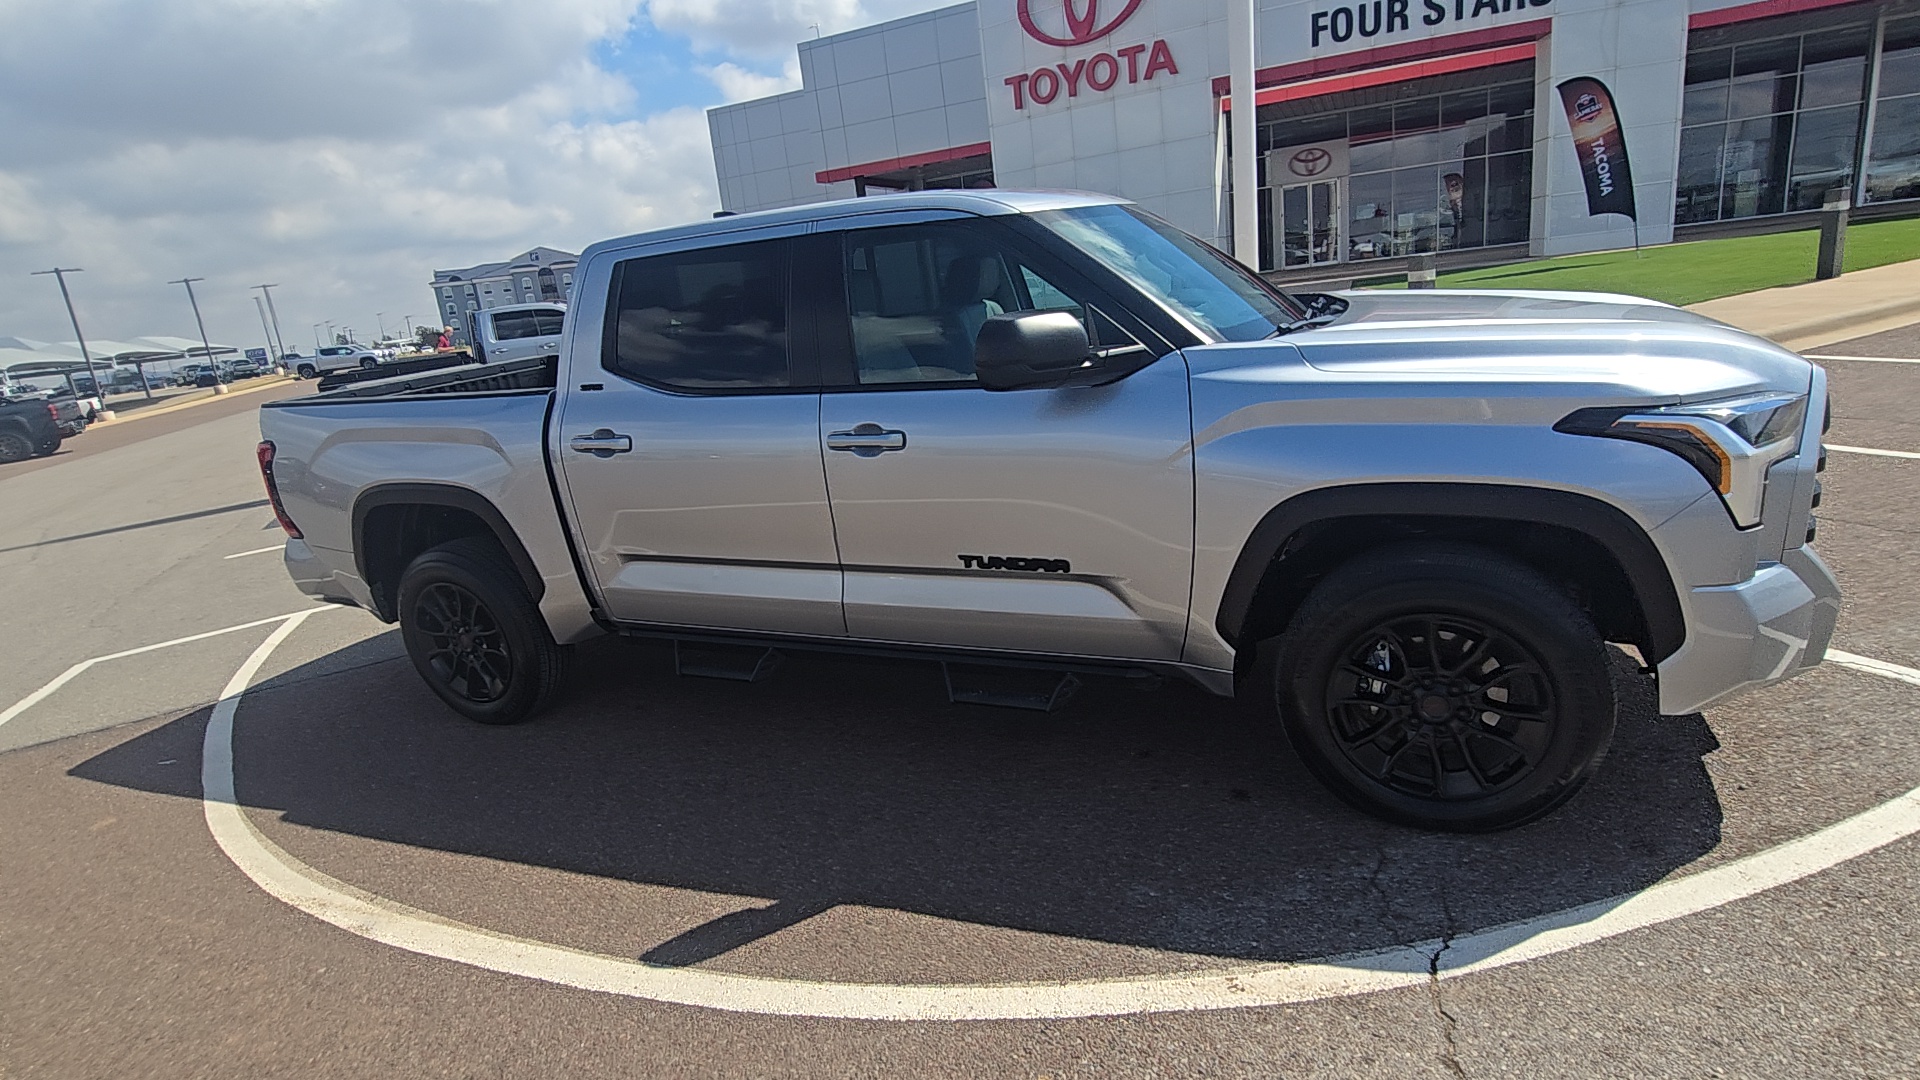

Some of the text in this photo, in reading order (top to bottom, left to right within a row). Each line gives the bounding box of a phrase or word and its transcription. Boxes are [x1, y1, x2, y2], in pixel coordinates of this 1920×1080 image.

[1311, 0, 1552, 47] FOUR STA
[1004, 39, 1179, 110] TOYOTA
[1591, 137, 1614, 197] TACOMA
[957, 555, 1070, 573] TUNDRA
